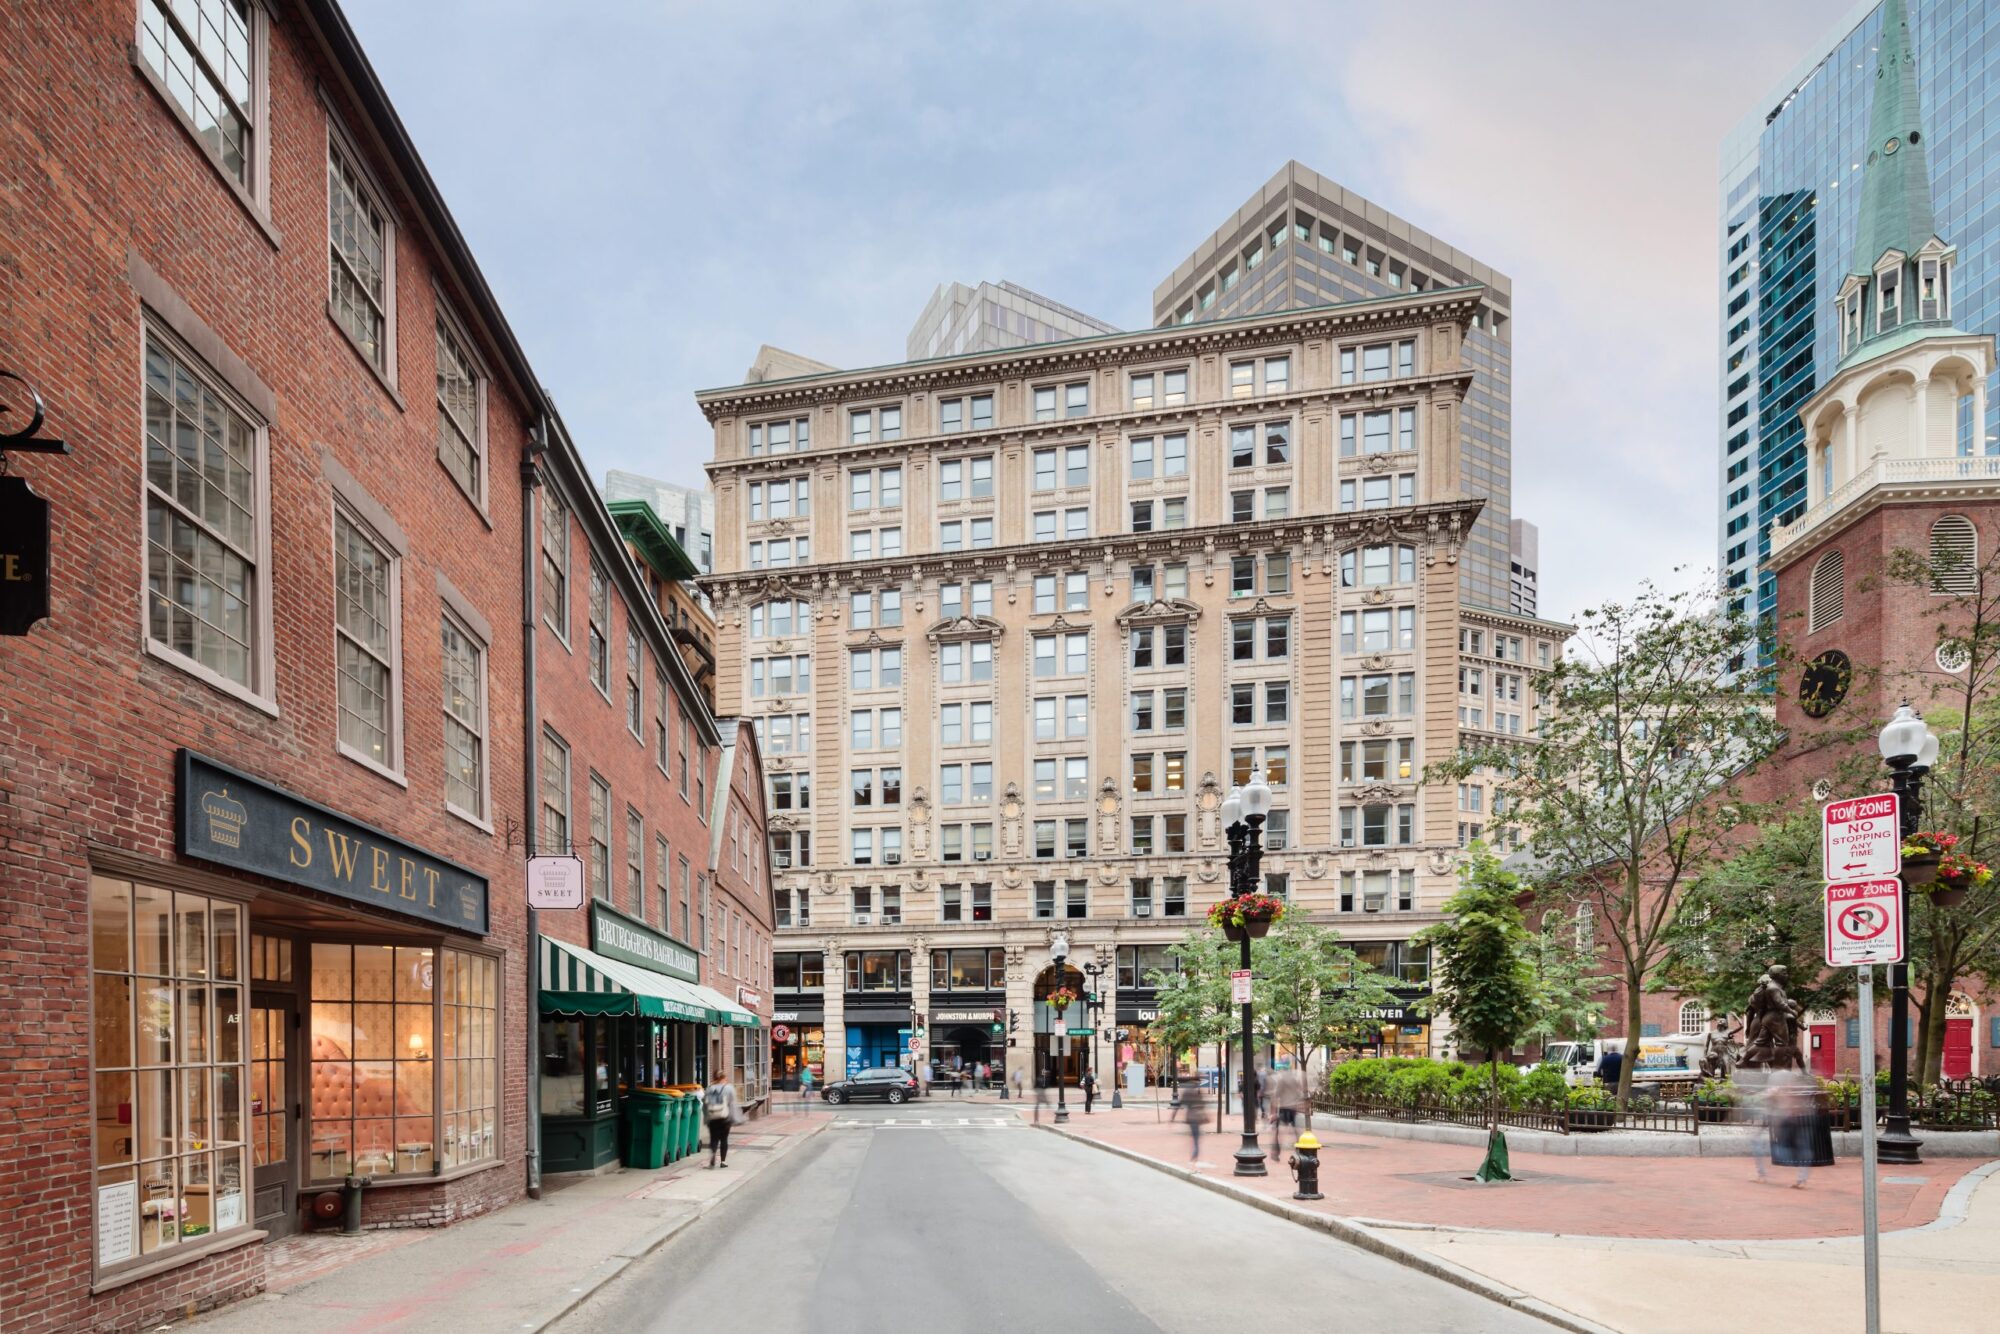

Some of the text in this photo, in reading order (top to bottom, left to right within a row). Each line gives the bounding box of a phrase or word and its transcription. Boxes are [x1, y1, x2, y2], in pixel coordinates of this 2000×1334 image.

[1831, 800, 1892, 821] TOW ZONE
[1848, 821, 1874, 834] NO
[1832, 831, 1891, 845] STOPPING
[1850, 842, 1872, 851] ANY
[1849, 849, 1873, 858] TIME
[290, 817, 440, 908] SWEET
[537, 889, 572, 897] SWEET
[1831, 884, 1895, 898] TOW ZONE
[596, 917, 697, 976] BRUEGGER'S BAGEL BAKERY
[936, 1012, 967, 1020] JOHNSTON
[973, 1012, 995, 1020] MURPH
[1138, 1009, 1156, 1020] lou
[1647, 1054, 1675, 1064] MORE
